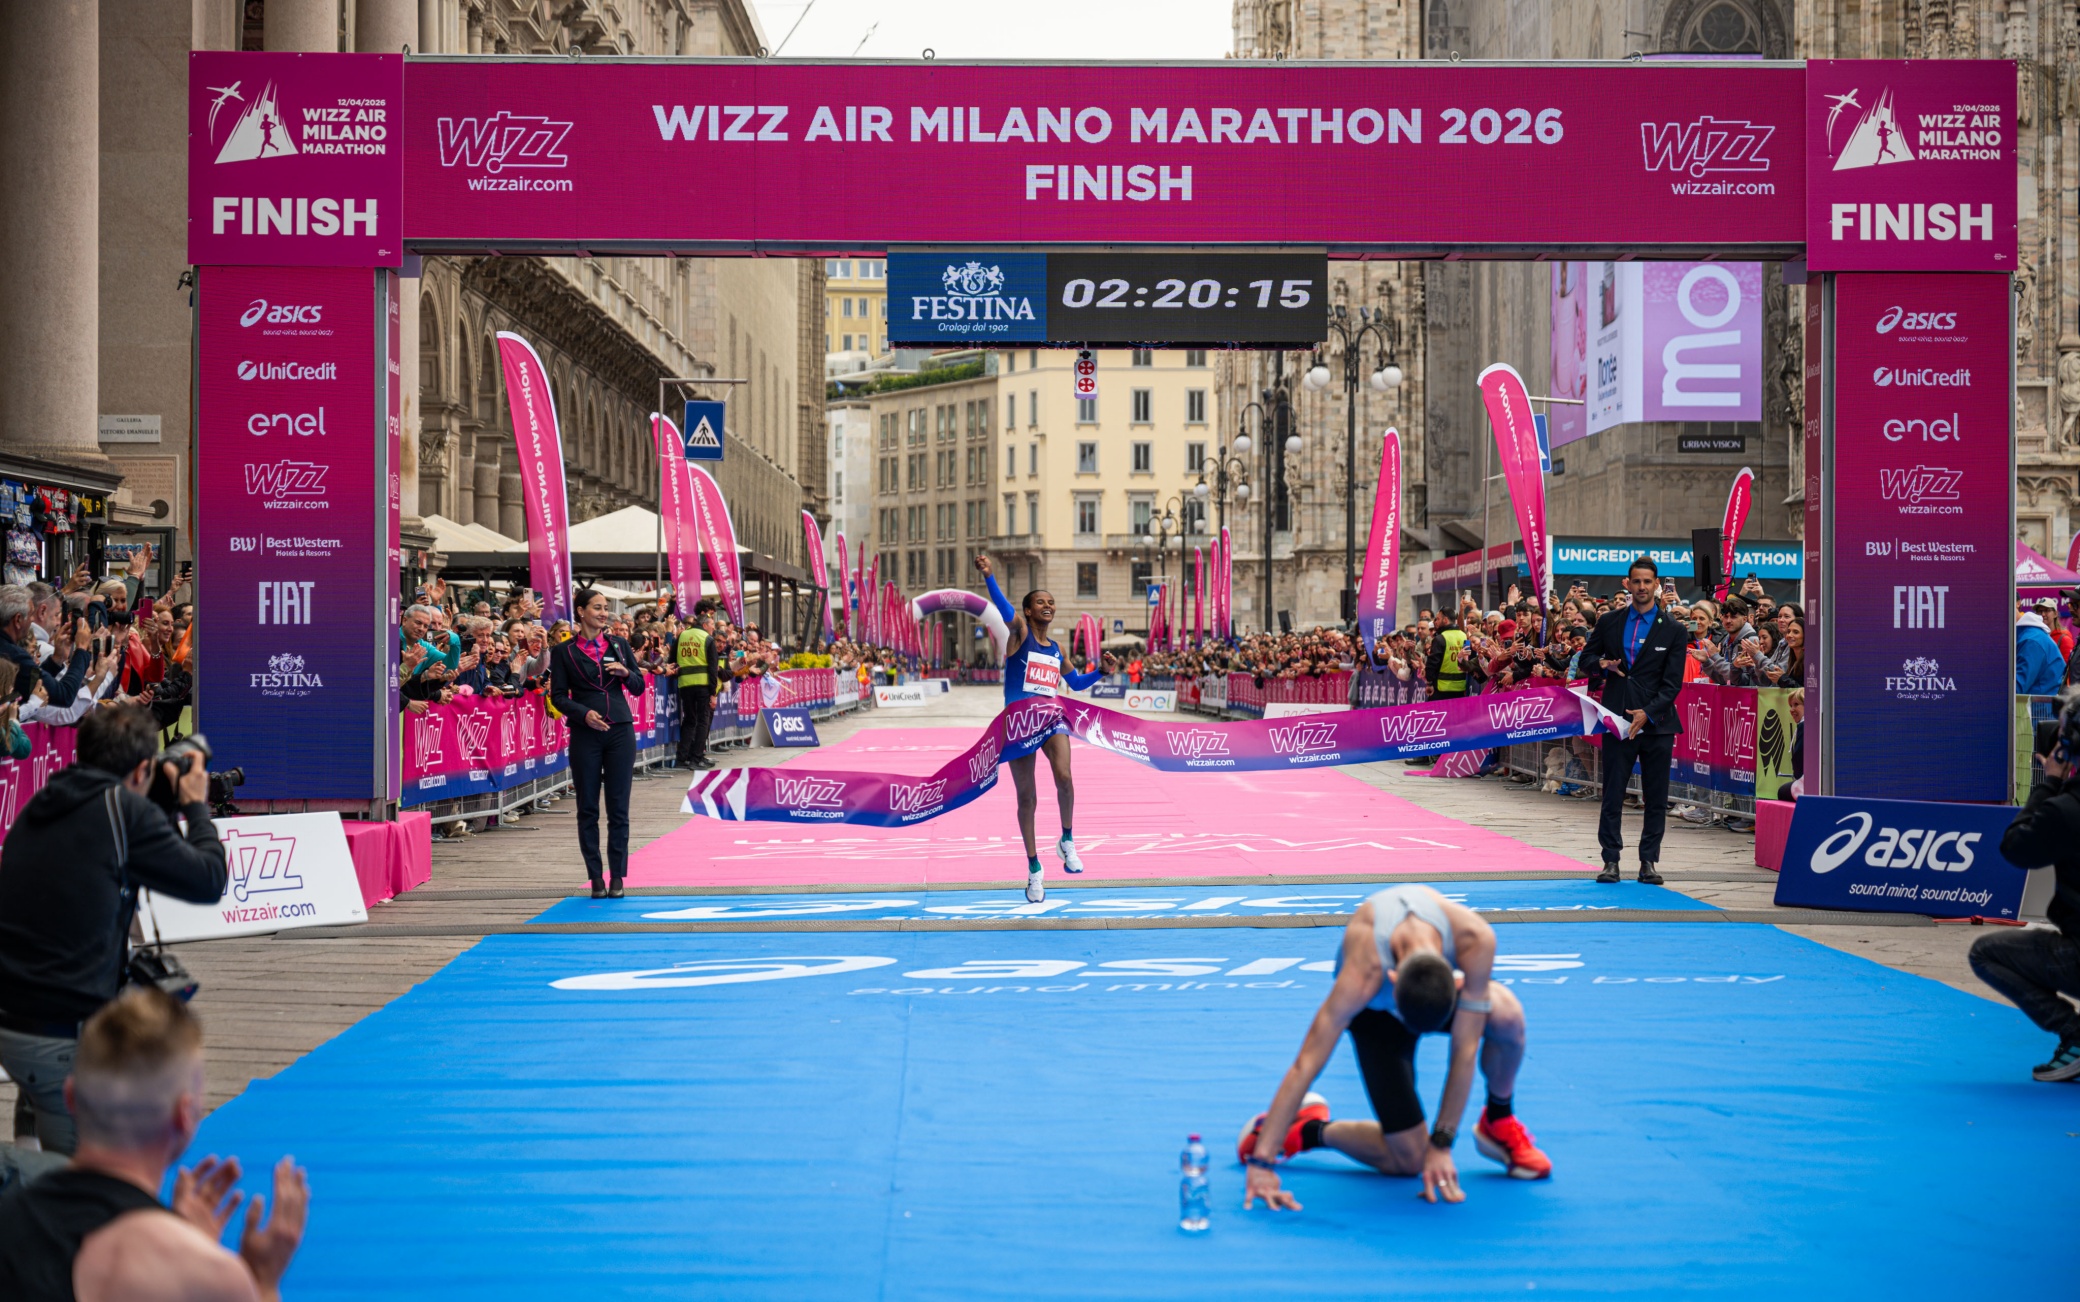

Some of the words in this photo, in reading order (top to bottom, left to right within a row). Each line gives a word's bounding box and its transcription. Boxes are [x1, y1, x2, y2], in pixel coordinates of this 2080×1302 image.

[338, 98, 386, 106] 12/04/2026
[302, 108, 351, 122] WIZZ
[355, 108, 386, 122] AIR
[1918, 114, 1967, 128] WIZZ
[1970, 114, 2000, 128] AIR
[652, 105, 789, 141] WIZZ
[804, 106, 893, 142] AIR
[910, 106, 1112, 143] MILANO
[1131, 107, 1422, 144] MARATHON
[1439, 108, 1563, 144] 2026
[303, 125, 387, 141] MILANO
[1919, 130, 2001, 146] MILANO
[303, 144, 386, 155] MARATHON
[437, 111, 574, 174] WIZZ
[1641, 115, 1775, 177] WIZZ
[1919, 149, 2000, 160] MARATHON
[468, 176, 573, 192] wizzair.com
[1026, 164, 1193, 201] FINISH
[1671, 180, 1775, 196] wizzair.com
[213, 197, 377, 236] FINISH
[1831, 203, 1993, 240] FINISH
[1062, 278, 1312, 308] 02:20:15
[267, 305, 322, 323] asics
[912, 296, 1036, 320] FESTINA
[938, 322, 971, 334] Orologi
[973, 322, 986, 333] dal
[988, 323, 1009, 332] 1902
[1902, 312, 1956, 330] asics
[259, 362, 336, 380] UniCredit
[1895, 368, 1971, 387] UniCredit
[247, 407, 326, 436] enel
[1883, 413, 1960, 441] enel
[1683, 441, 1710, 449] URBAN
[1712, 441, 1741, 449] VISION
[264, 498, 329, 509] wizzair.com
[1899, 503, 1963, 515] wizzair.com
[230, 537, 256, 551] BW
[266, 537, 292, 548] Best
[1866, 542, 1892, 556] BW
[1901, 541, 1926, 553] Best
[1559, 548, 1645, 563] UNICREDIT
[258, 582, 315, 625] FIAT
[1893, 586, 1949, 629] FIAT
[250, 673, 323, 688] FESTINA
[1885, 677, 1957, 691] FESTINA
[888, 692, 921, 701] UniCredit
[1102, 686, 1119, 694] asics
[1128, 693, 1171, 709] enel
[1488, 696, 1554, 730] WIZZ
[782, 716, 805, 732] asics
[1380, 710, 1447, 743] WIZZ
[1506, 725, 1558, 739] wizzair.com
[1112, 730, 1132, 742] WIZZ
[1133, 735, 1146, 745] AIR
[1166, 728, 1230, 759] WIZZ
[1268, 721, 1338, 754] WIZZ
[1113, 739, 1149, 754] MILANO
[1398, 739, 1450, 753] wizzair.com
[1186, 758, 1235, 767] wizzair.com
[1289, 752, 1341, 764] wizzair.com
[775, 776, 846, 808] WIZZ
[890, 778, 947, 812] WIZZ
[789, 809, 844, 819] wizzair.com
[902, 804, 944, 822] wizzair.com
[1865, 827, 1982, 872] asics
[1849, 883, 1888, 896] sound
[1887, 884, 1918, 900] mind,
[1920, 887, 1961, 902] sound
[1961, 888, 1992, 906] body
[222, 901, 316, 924] wizzair.com
[847, 982, 1089, 996] sound
[1592, 974, 1785, 985] body
